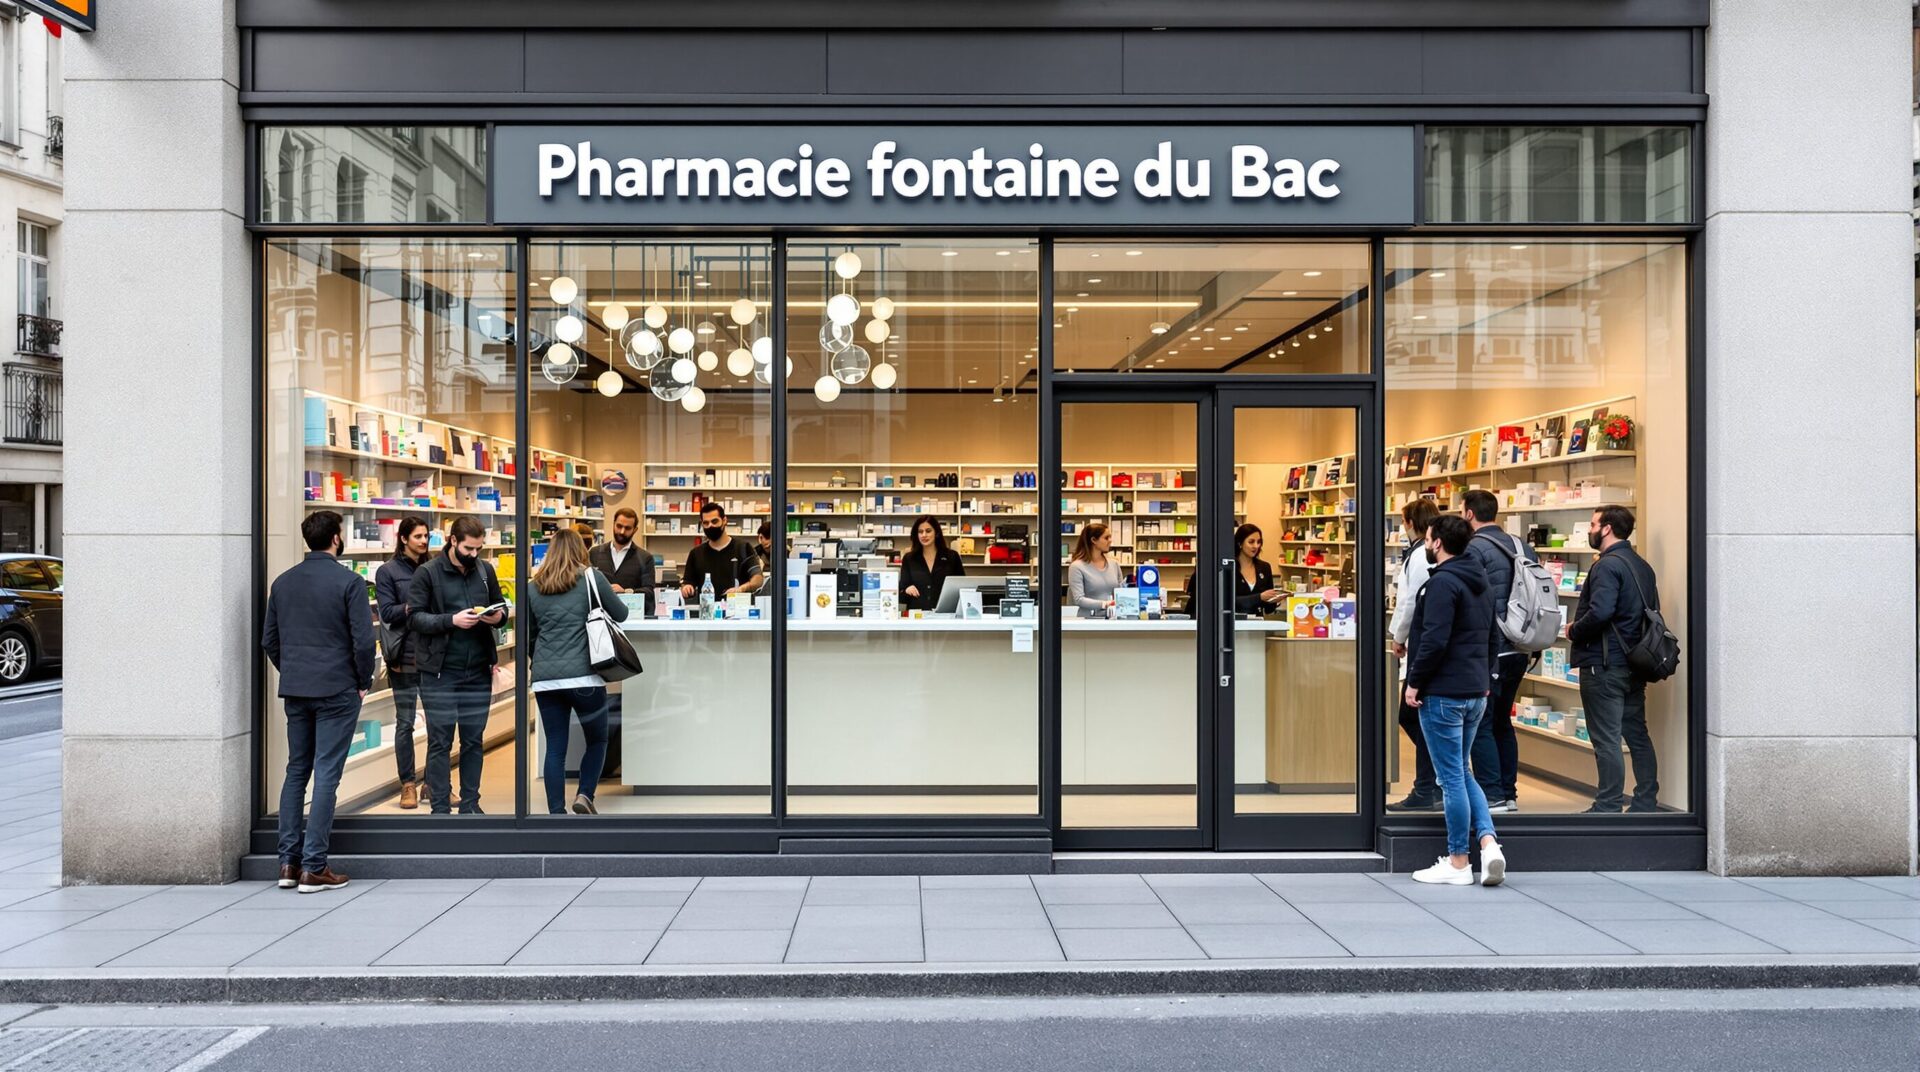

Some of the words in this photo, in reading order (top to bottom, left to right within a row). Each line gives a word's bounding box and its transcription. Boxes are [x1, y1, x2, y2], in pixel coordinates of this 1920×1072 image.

[538, 142, 850, 198] Pharmacie
[867, 142, 1120, 198] fontaine
[1134, 140, 1211, 199] du
[1231, 144, 1342, 199] Bac
